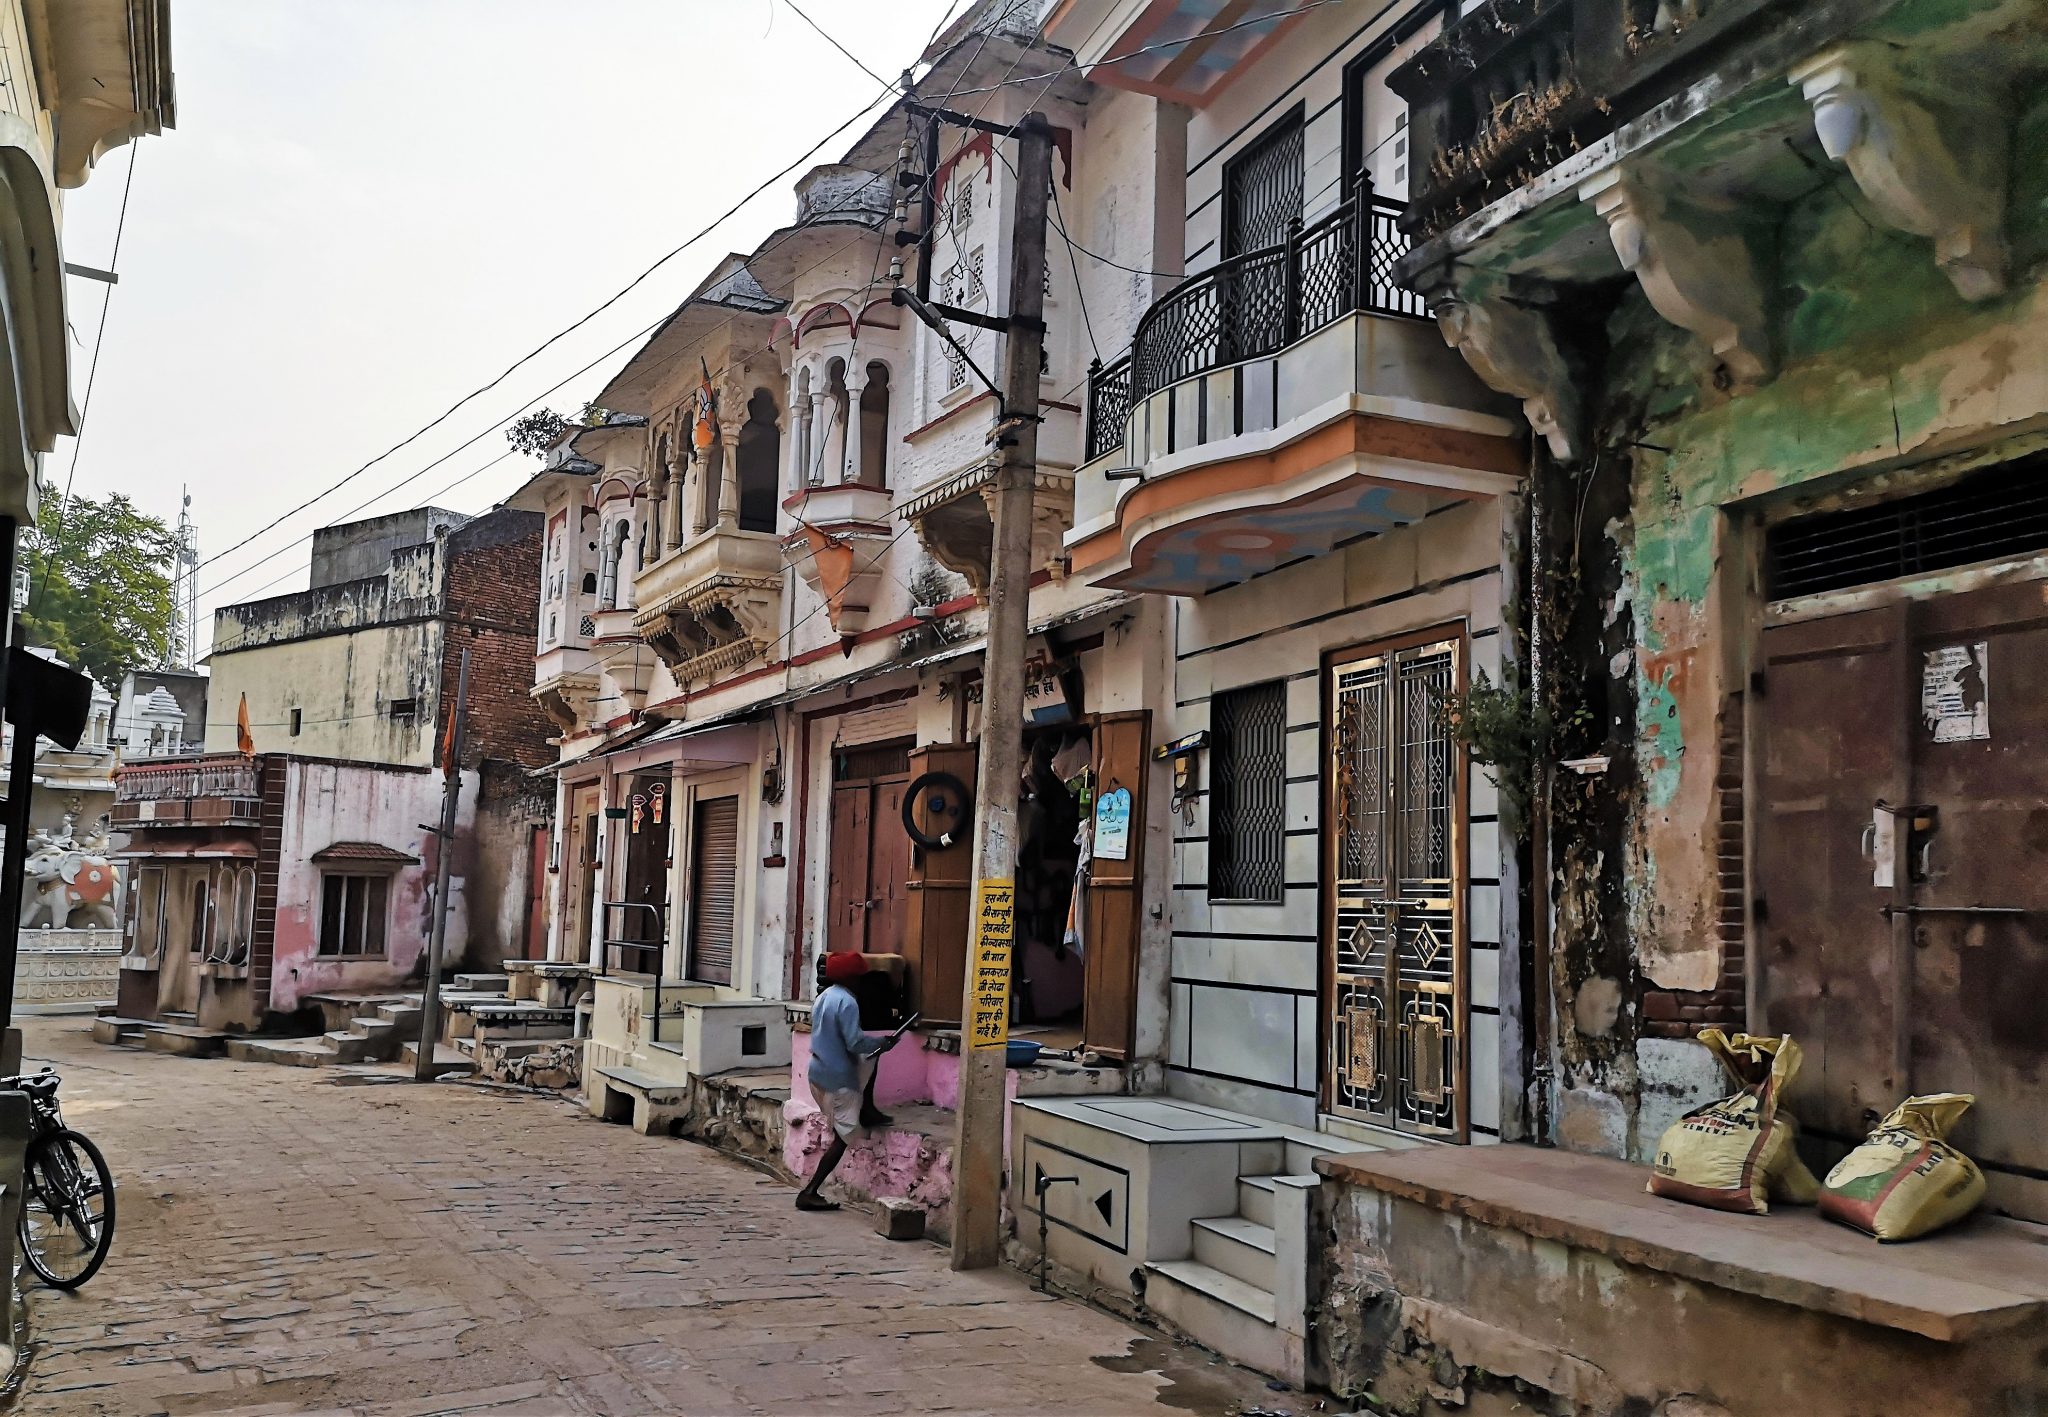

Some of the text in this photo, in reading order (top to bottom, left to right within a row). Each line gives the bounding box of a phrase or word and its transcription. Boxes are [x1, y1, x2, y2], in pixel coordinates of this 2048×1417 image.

[985, 894, 997, 904] इस
[981, 905, 991, 917] की
[980, 934, 989, 947] की
[979, 993, 1004, 1007] परिवार
[976, 1008, 1004, 1023] द्वारा की
[976, 1023, 990, 1037] गई
[1682, 1123, 1729, 1136] CEMENT
